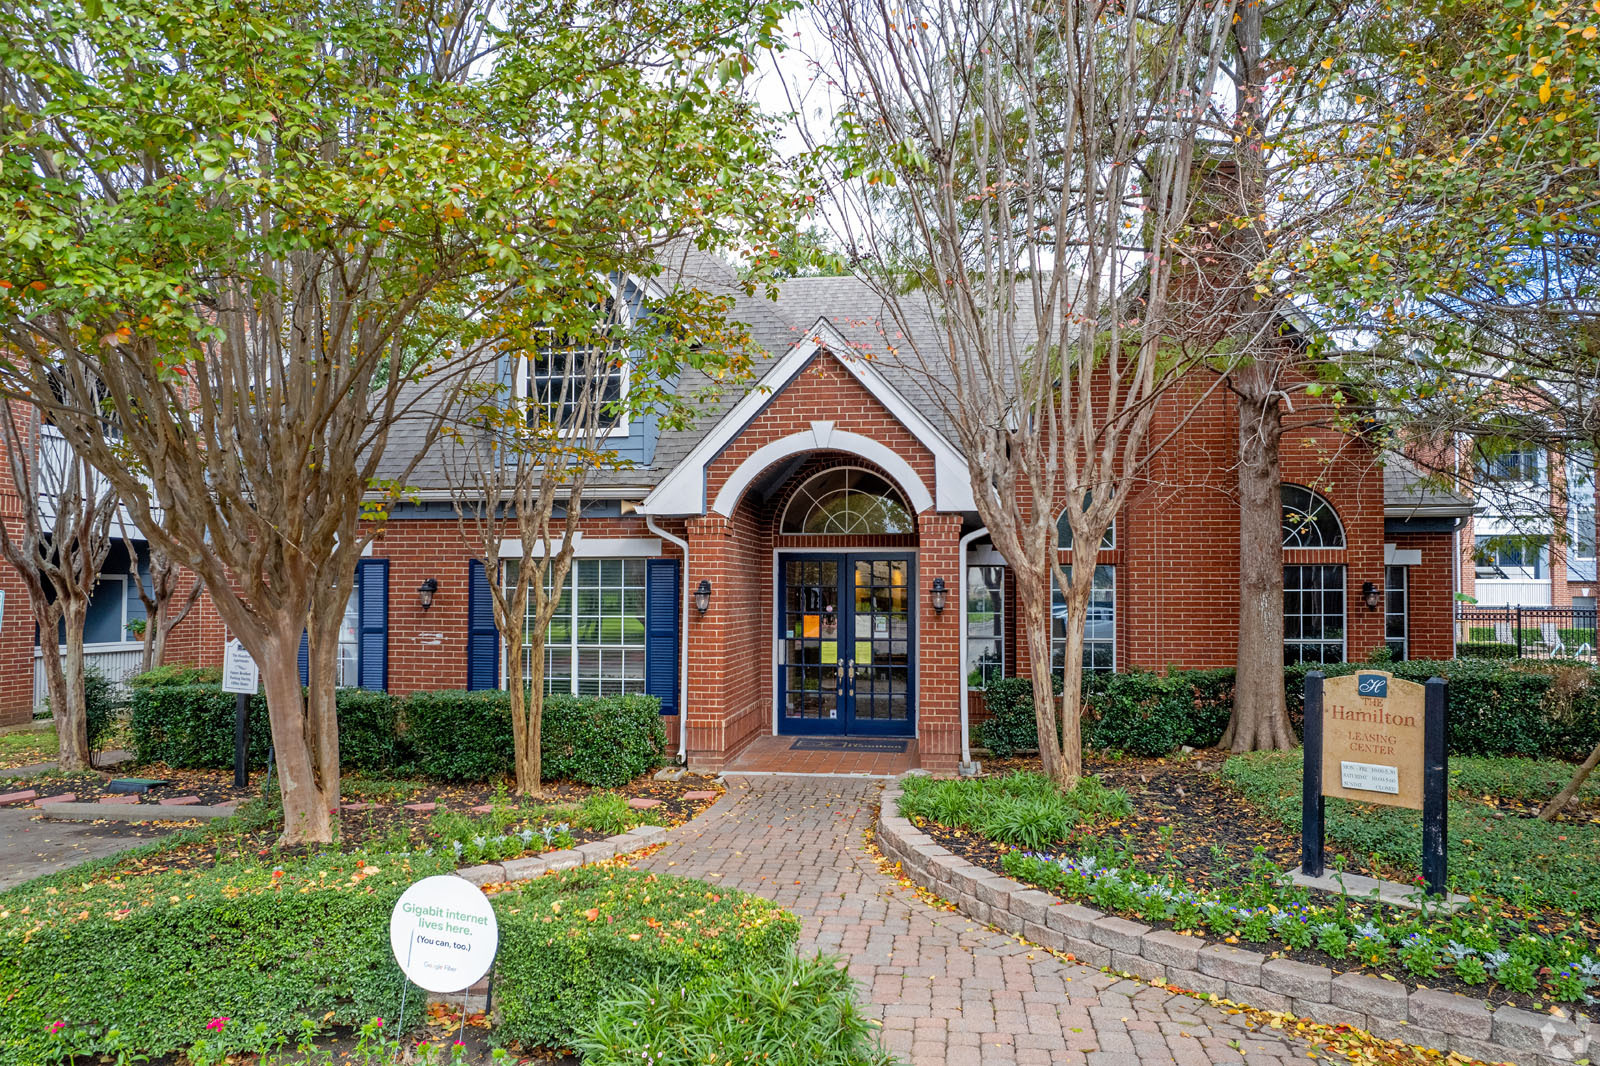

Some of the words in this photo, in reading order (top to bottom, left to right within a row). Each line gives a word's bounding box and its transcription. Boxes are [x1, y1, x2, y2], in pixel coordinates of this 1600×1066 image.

[1361, 697, 1384, 707] THE
[1332, 705, 1417, 727] Hamilton
[1348, 731, 1397, 745] LEASING
[1349, 743, 1395, 755] CENTER
[402, 902, 444, 917] Gigabit
[446, 908, 489, 926] internet
[418, 918, 443, 931] lives
[445, 921, 473, 936] here.
[416, 935, 434, 945] (You
[435, 939, 452, 949] can,
[453, 941, 471, 952] too.)
[424, 961, 443, 971] Gogle
